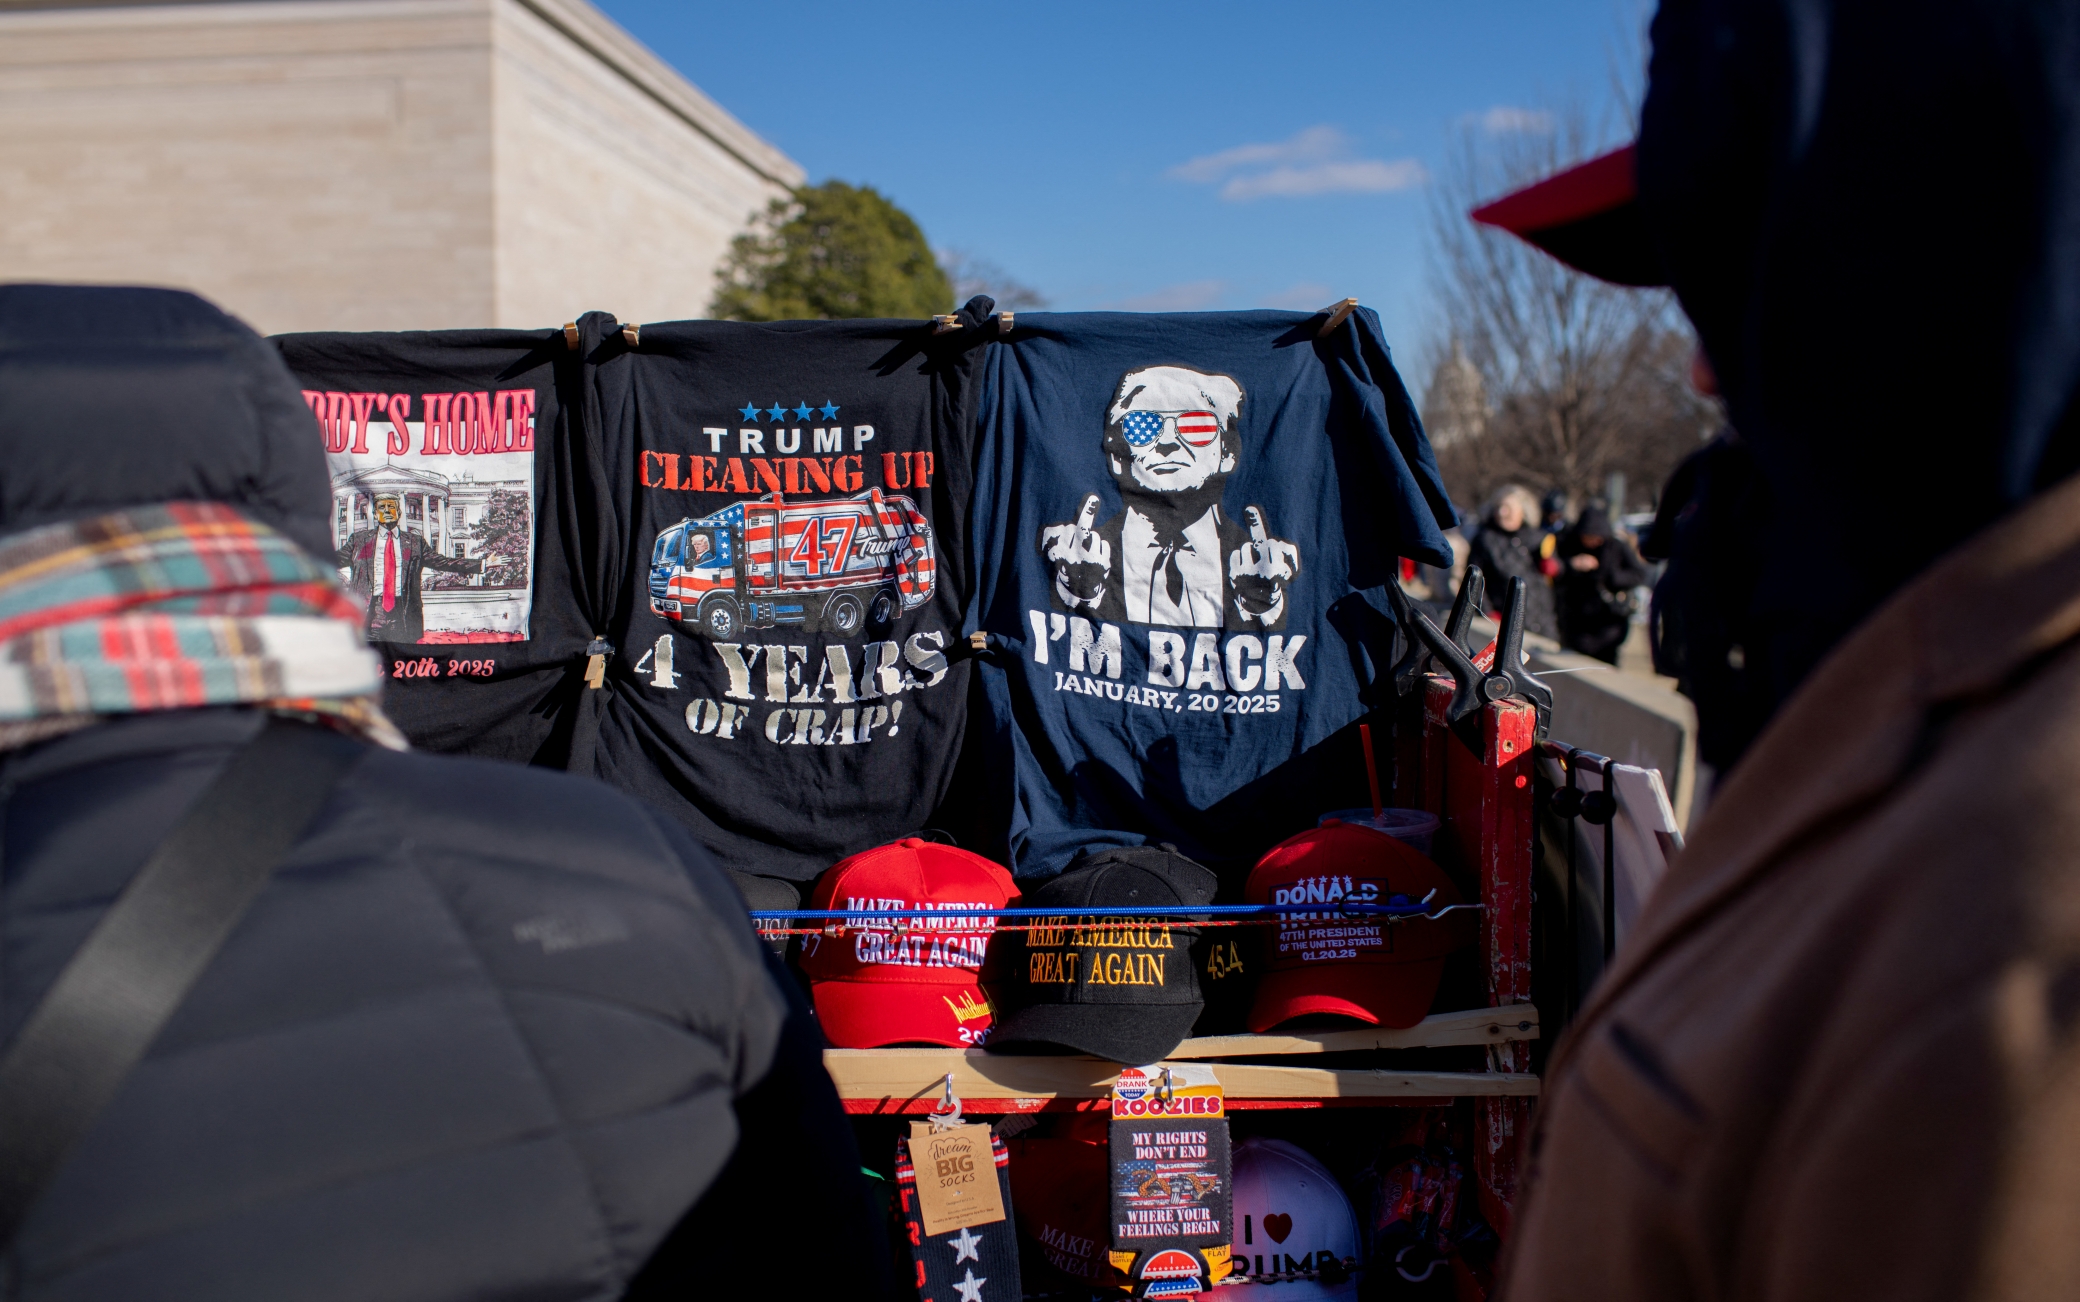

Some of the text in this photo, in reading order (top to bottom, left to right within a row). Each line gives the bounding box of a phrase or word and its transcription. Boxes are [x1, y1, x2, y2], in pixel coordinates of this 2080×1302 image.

[301, 388, 535, 456] DDY'S HOME
[703, 425, 874, 454] TRUMP
[640, 451, 935, 494] CLEANING UP
[789, 513, 860, 578] 47
[854, 535, 911, 558] Trump
[1029, 609, 1307, 692] I'M BACK
[393, 657, 440, 678] 20th
[447, 659, 495, 677] 2025
[634, 630, 949, 704] 4 YEARS
[1054, 671, 1281, 714] JANUARY, 20 2025
[685, 698, 903, 746] OF CRAP!
[1275, 880, 1379, 906] DONALD
[844, 897, 997, 934] MAKE AMERICA
[752, 918, 791, 941] RICA
[1025, 915, 1175, 949] MAKE AMERICA
[1280, 926, 1381, 942] 47TH PRESIDENT
[855, 931, 988, 968] GREAT AGAIN
[1279, 937, 1383, 953] OF THE UNITED STATES
[1302, 948, 1357, 961] 01.20.25
[1029, 952, 1165, 986] GREAT AGAIN
[1116, 1080, 1148, 1088] DRANK
[1114, 1097, 1220, 1115] KOOZIES
[933, 1143, 972, 1161] dream
[1132, 1131, 1208, 1146] MY RIGHTS
[935, 1154, 975, 1178] BIG
[1135, 1145, 1208, 1160] DON'T END
[939, 1172, 976, 1189] SOCKS
[1127, 1207, 1211, 1224] WHERE YOUR
[1039, 1223, 1095, 1258] MAKE
[1118, 1220, 1220, 1239] FEELINGS BEGIN
[1244, 1214, 1253, 1245] I
[1043, 1247, 1102, 1280] GREAT
[1228, 1250, 1336, 1285] RUMP
